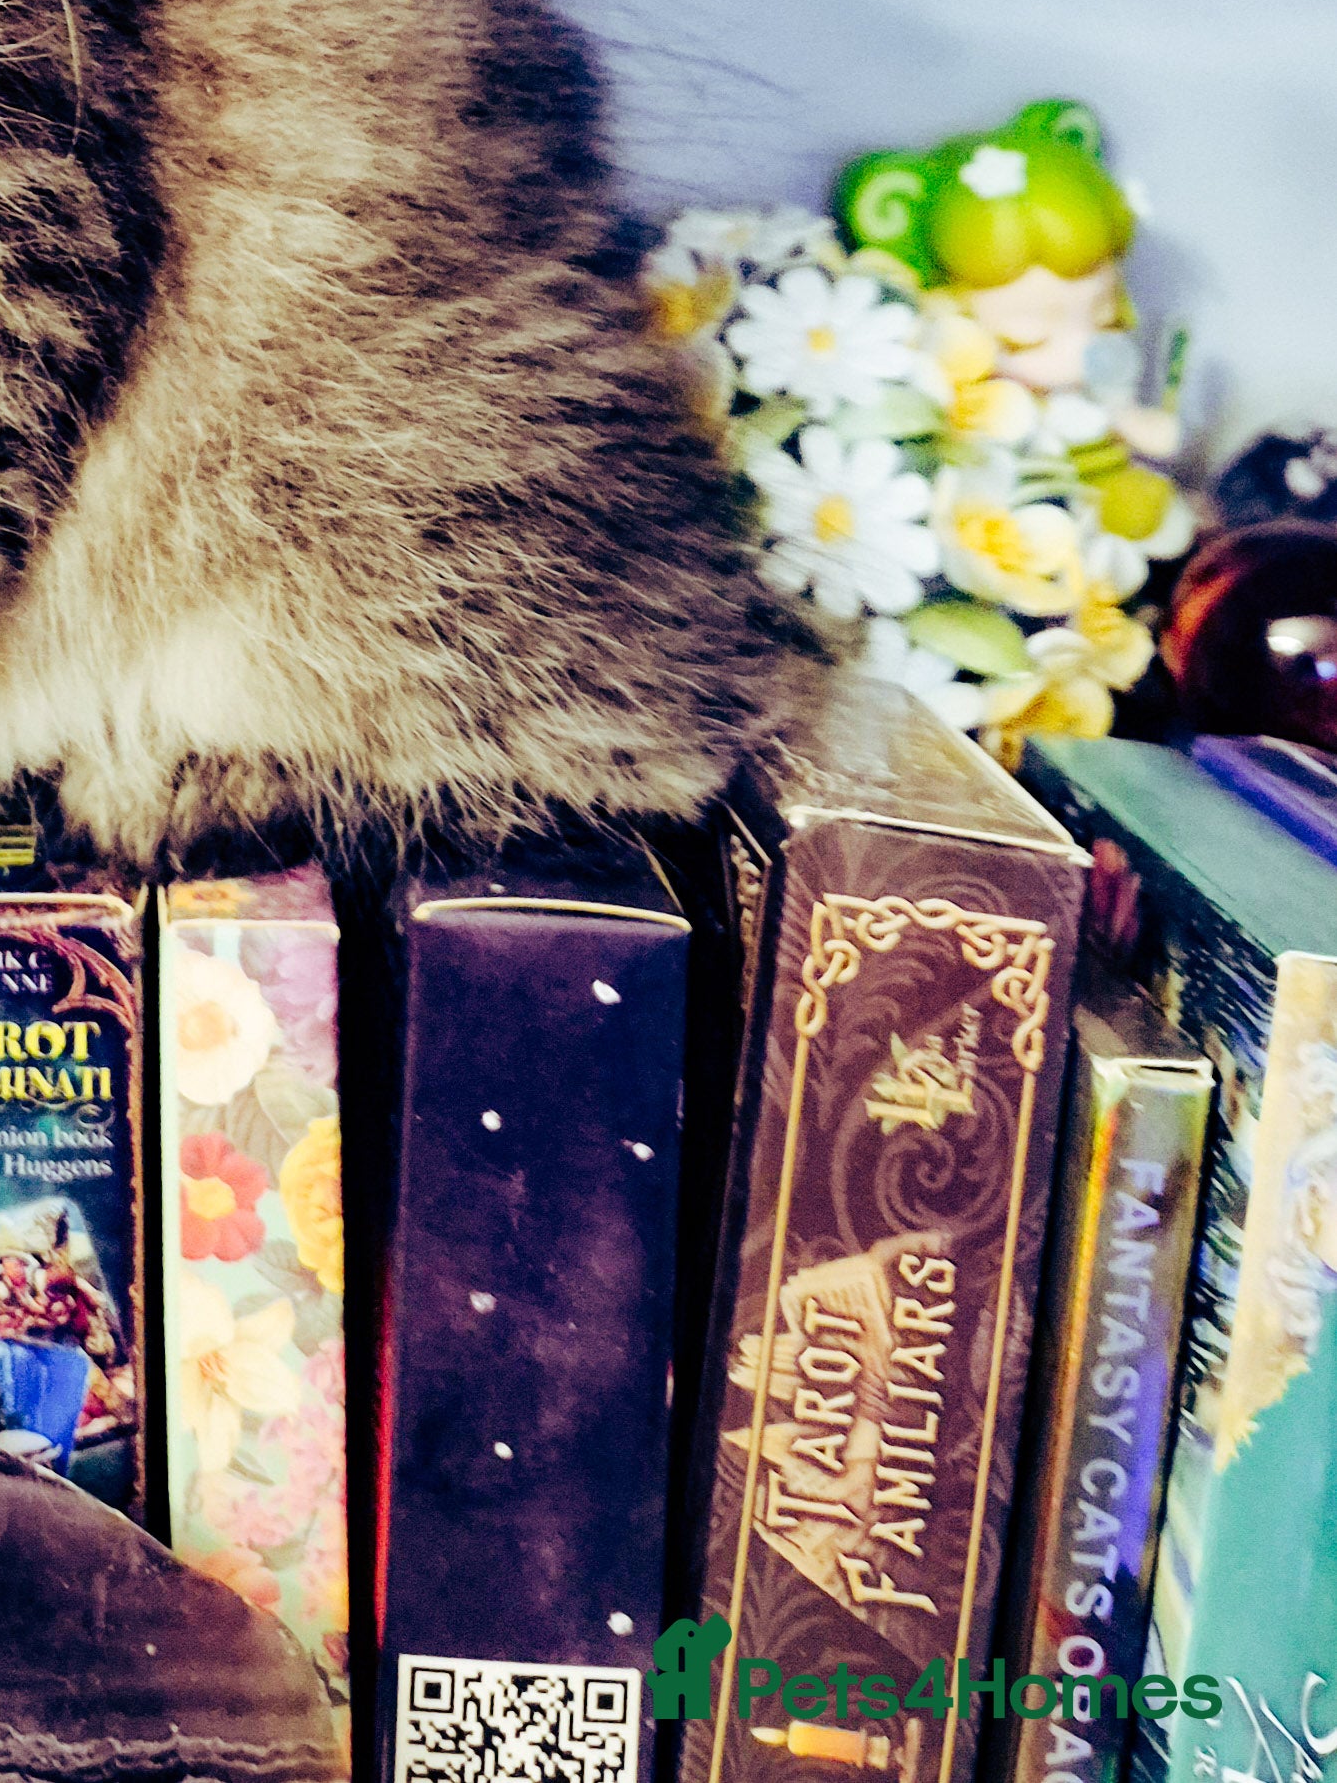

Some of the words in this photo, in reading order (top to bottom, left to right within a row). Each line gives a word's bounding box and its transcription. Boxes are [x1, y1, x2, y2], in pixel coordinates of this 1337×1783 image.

[3, 1152, 114, 1183] Huggens
[53, 1124, 115, 1148] book
[1089, 1157, 1164, 1445] FANTASY
[767, 1296, 864, 1528] TAROT
[837, 1253, 957, 1616] FAMILIARS
[1064, 1458, 1128, 1621] CATS
